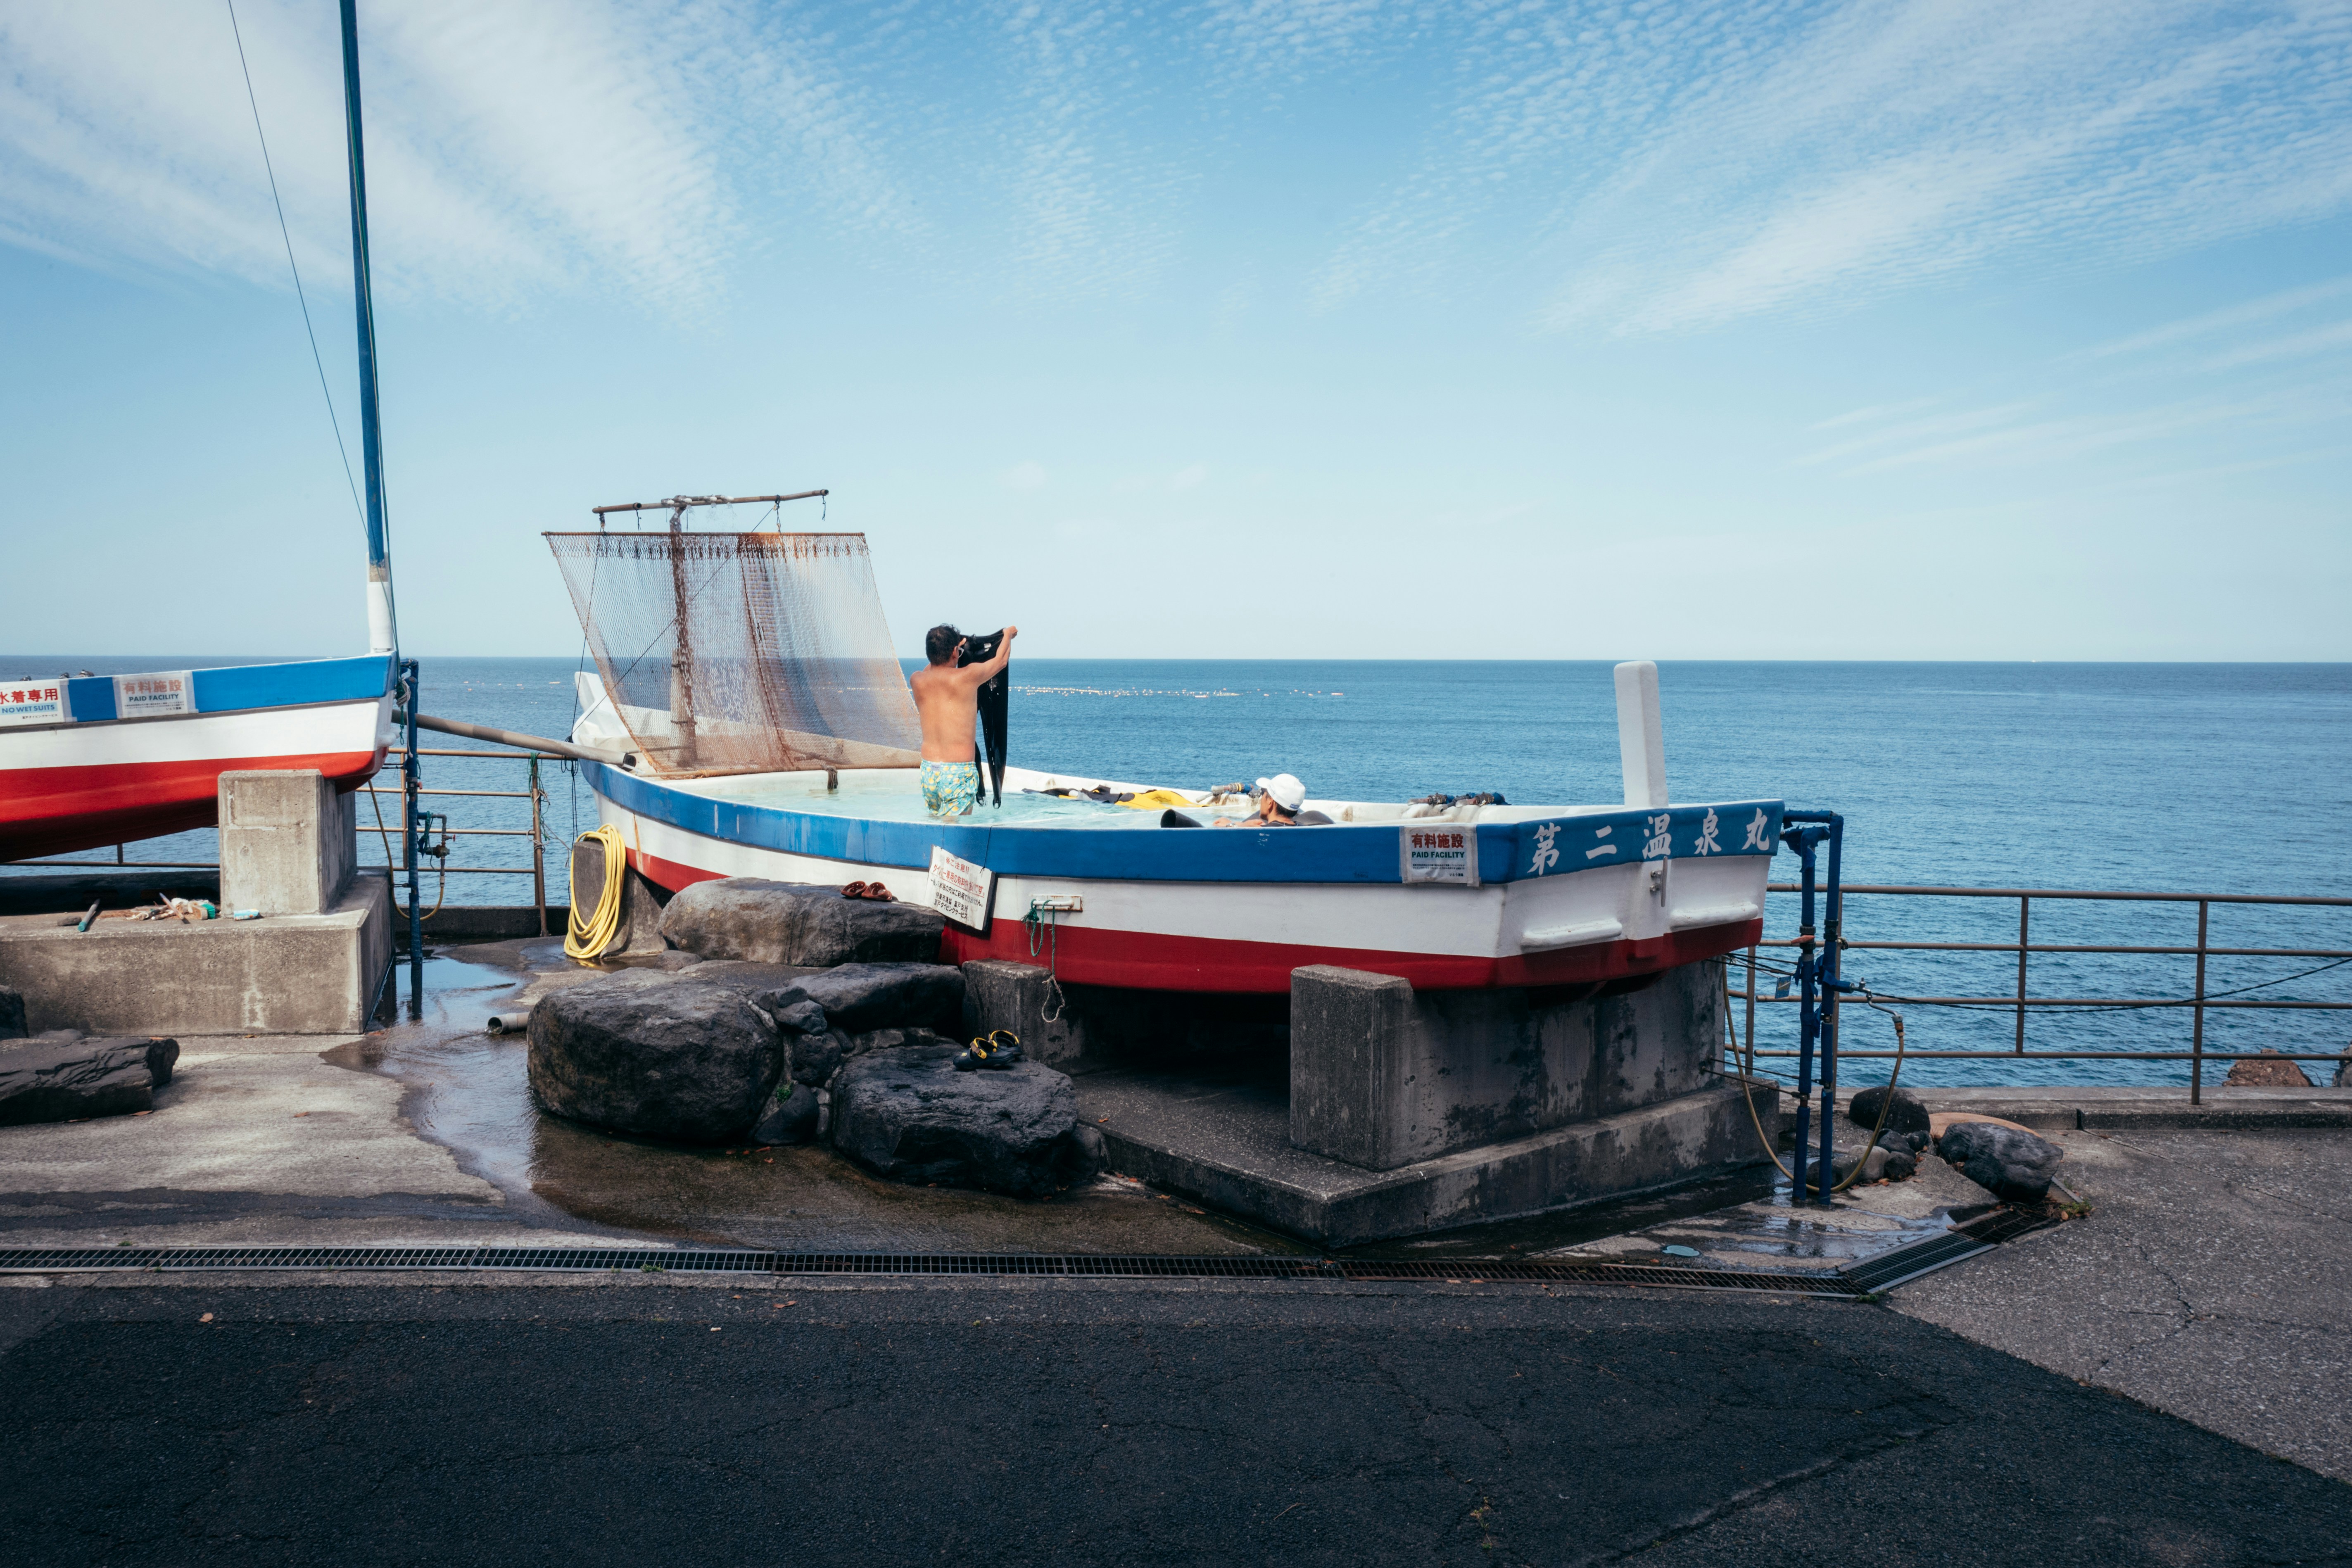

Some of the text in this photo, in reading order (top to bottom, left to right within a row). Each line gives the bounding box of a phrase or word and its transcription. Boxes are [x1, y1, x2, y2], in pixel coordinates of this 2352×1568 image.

[122, 679, 182, 694] 有料施設
[0, 688, 58, 704] 水着専用
[1411, 833, 1464, 848] 有料施設
[1527, 807, 1770, 876] 第二温泉丸
